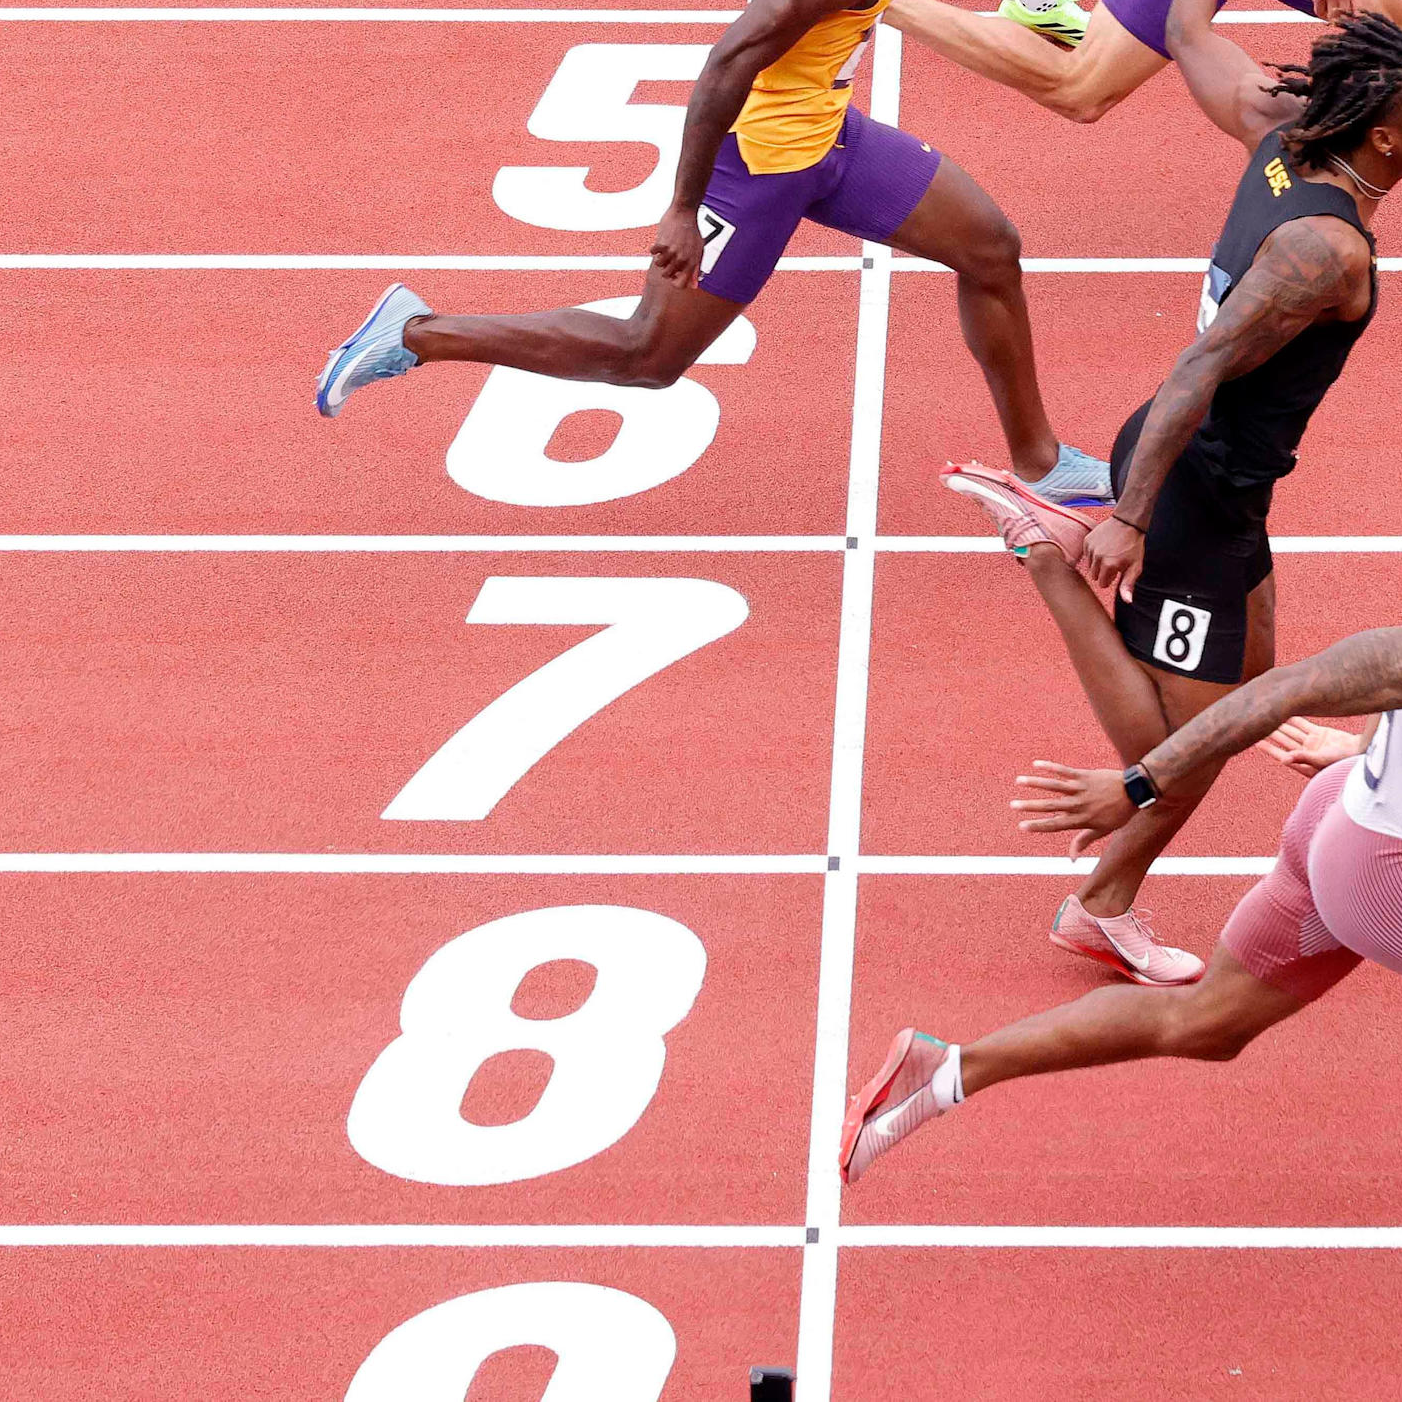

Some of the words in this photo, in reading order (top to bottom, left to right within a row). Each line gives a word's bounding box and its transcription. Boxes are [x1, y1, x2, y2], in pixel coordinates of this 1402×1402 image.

[492, 43, 716, 232] 5
[704, 214, 725, 247] 7
[1263, 157, 1292, 198] USC
[447, 296, 758, 507] 6
[380, 576, 750, 821] 7
[1165, 608, 1195, 663] 8
[347, 904, 707, 1186] 8
